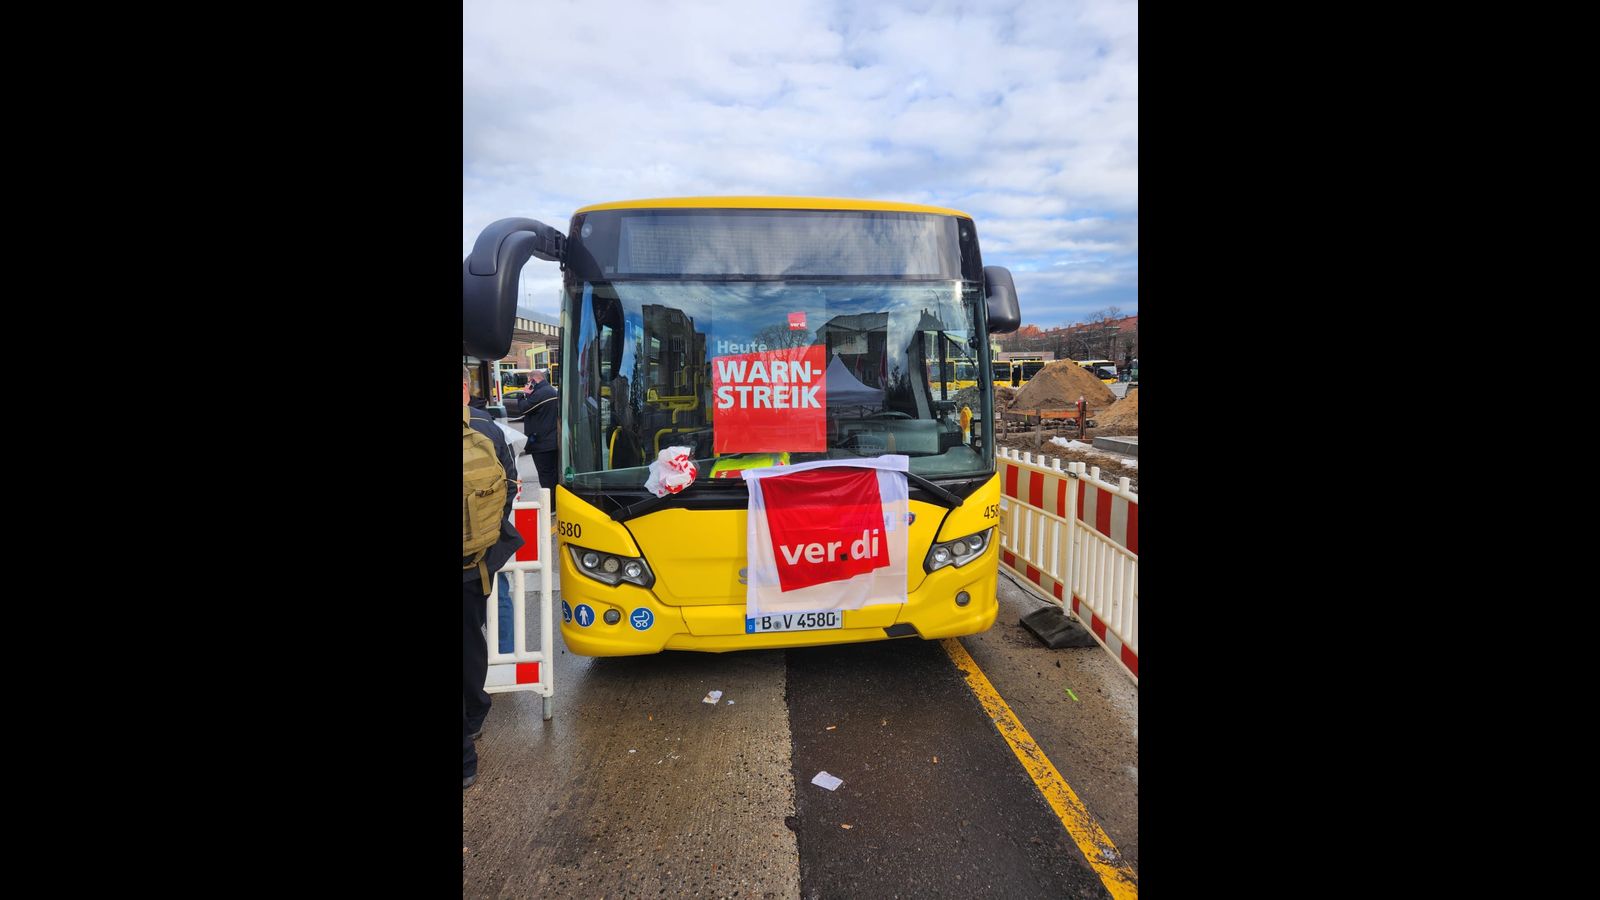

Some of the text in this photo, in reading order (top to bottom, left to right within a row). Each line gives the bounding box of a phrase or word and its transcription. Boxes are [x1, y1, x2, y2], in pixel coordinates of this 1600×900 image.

[717, 340, 768, 354] Heute
[717, 360, 822, 383] WARN-
[717, 385, 822, 409] STREIK
[780, 528, 879, 566] ver.di
[761, 611, 836, 630] B V 4580
